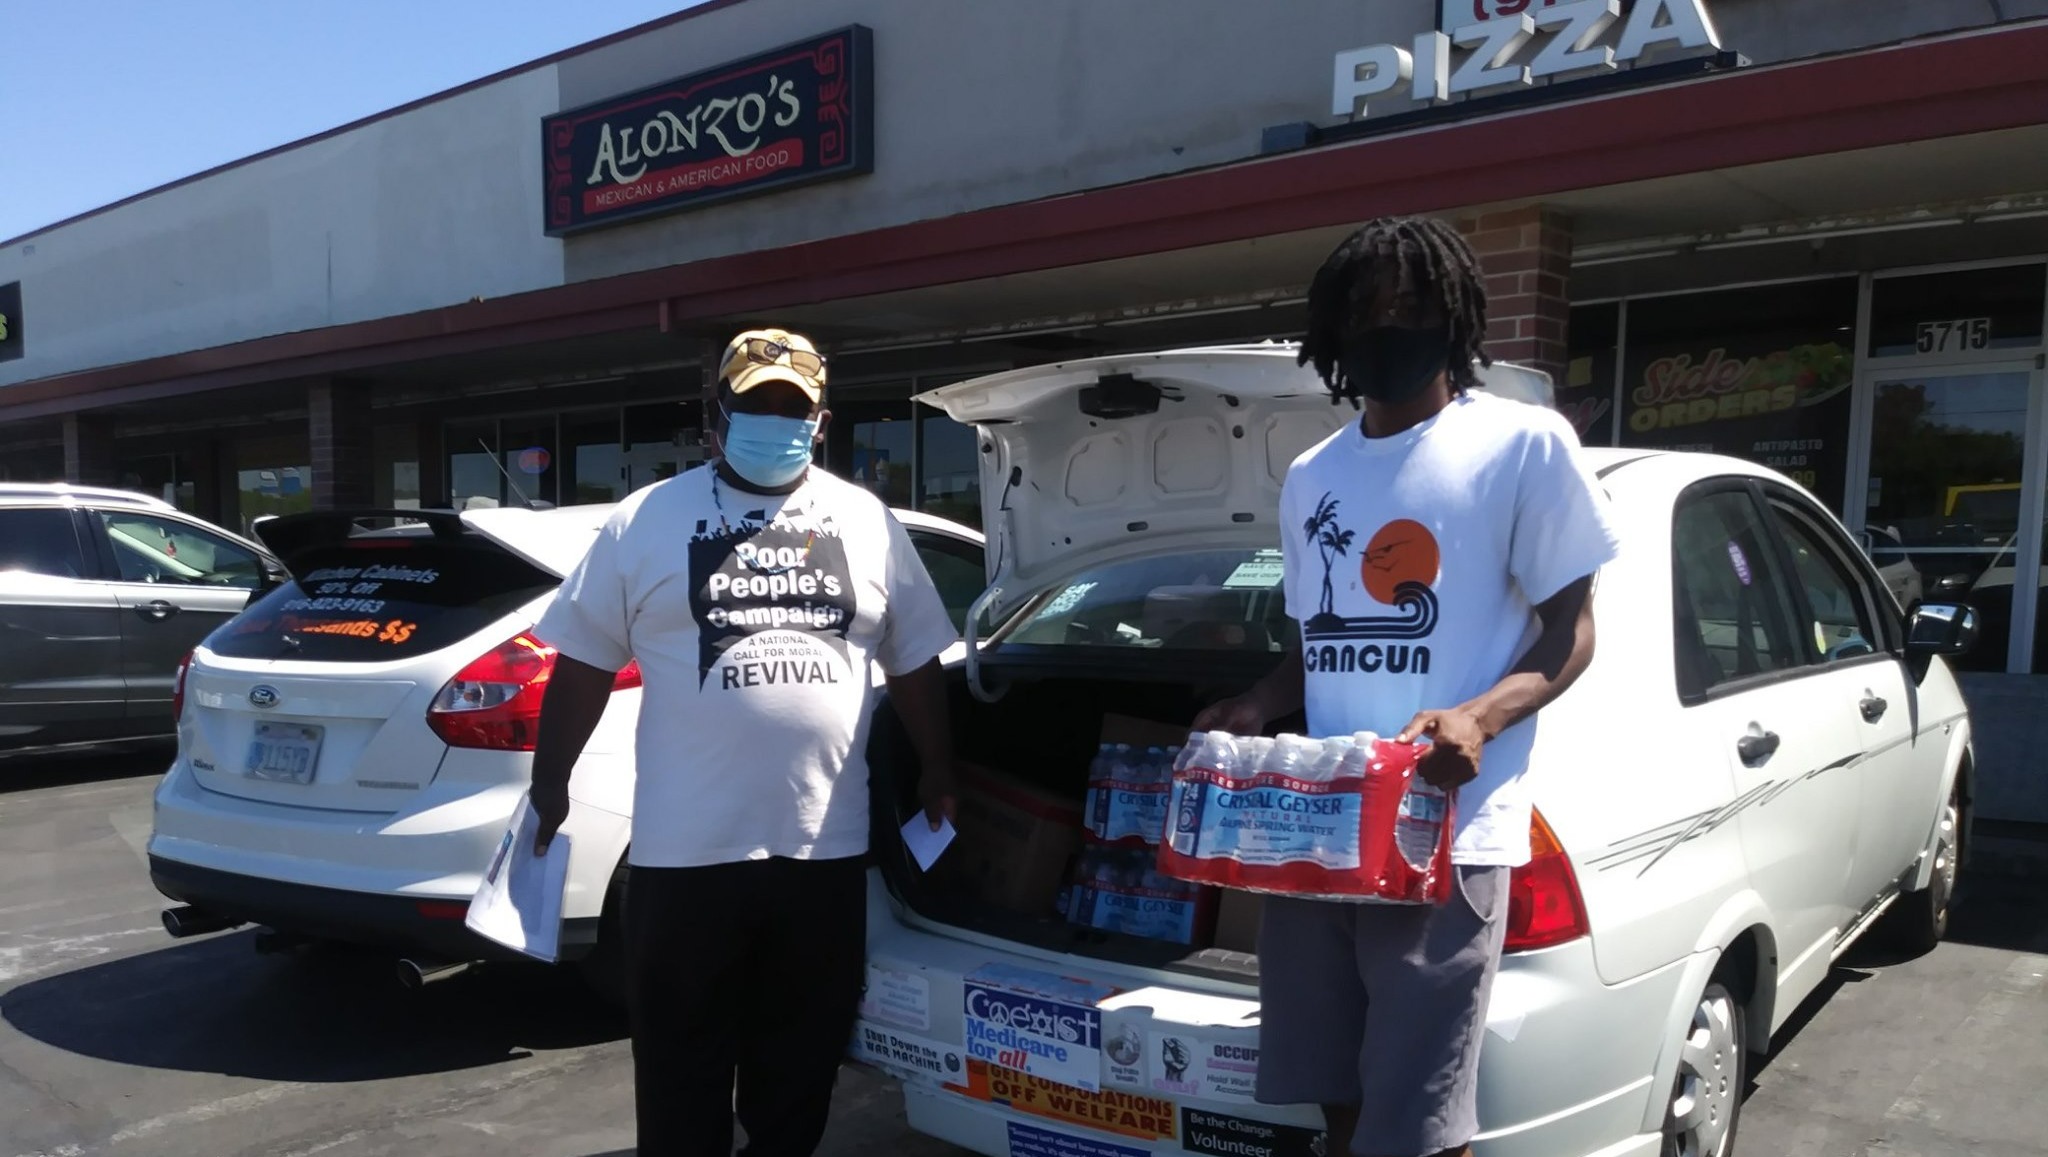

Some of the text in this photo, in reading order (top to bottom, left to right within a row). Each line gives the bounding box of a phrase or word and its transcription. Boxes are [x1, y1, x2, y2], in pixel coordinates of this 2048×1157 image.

[1332, 0, 1720, 117] PIZZA
[586, 74, 801, 184] ALONZO'S
[595, 150, 790, 207] MEXICAN & AMERICAN FOOD
[1917, 319, 1989, 354] 5715
[1632, 347, 1756, 406] Side
[1630, 384, 1797, 432] ORDERS
[1752, 438, 1824, 453] ANTIPASTO
[1766, 455, 1807, 467] SALAD
[734, 542, 807, 570] Poor
[360, 564, 439, 584] Cabinets
[708, 568, 842, 601] People's
[706, 601, 844, 629] Campaign
[733, 648, 823, 661] CALL FOR MORAL
[747, 635, 809, 647] A NATIONAL
[1305, 644, 1431, 675] CANCUN
[721, 660, 838, 690] REVIVAL
[1277, 794, 1343, 816] GEYSER
[1254, 820, 1296, 833] SPRING
[1297, 824, 1337, 836] WATER
[864, 1028, 937, 1059] Shut Down the
[966, 1017, 1068, 1062] Medicare
[966, 1036, 996, 1060] for
[1214, 1044, 1260, 1061] OCCUP
[865, 1041, 943, 1073] WAR MACHINE
[990, 1064, 1019, 1084] GET
[1026, 1074, 1172, 1118] CORPORATIONS
[992, 1080, 1173, 1137] OFF WELFARE
[1190, 1113, 1276, 1138] Be the Change.
[1190, 1130, 1273, 1157] Volunteer
